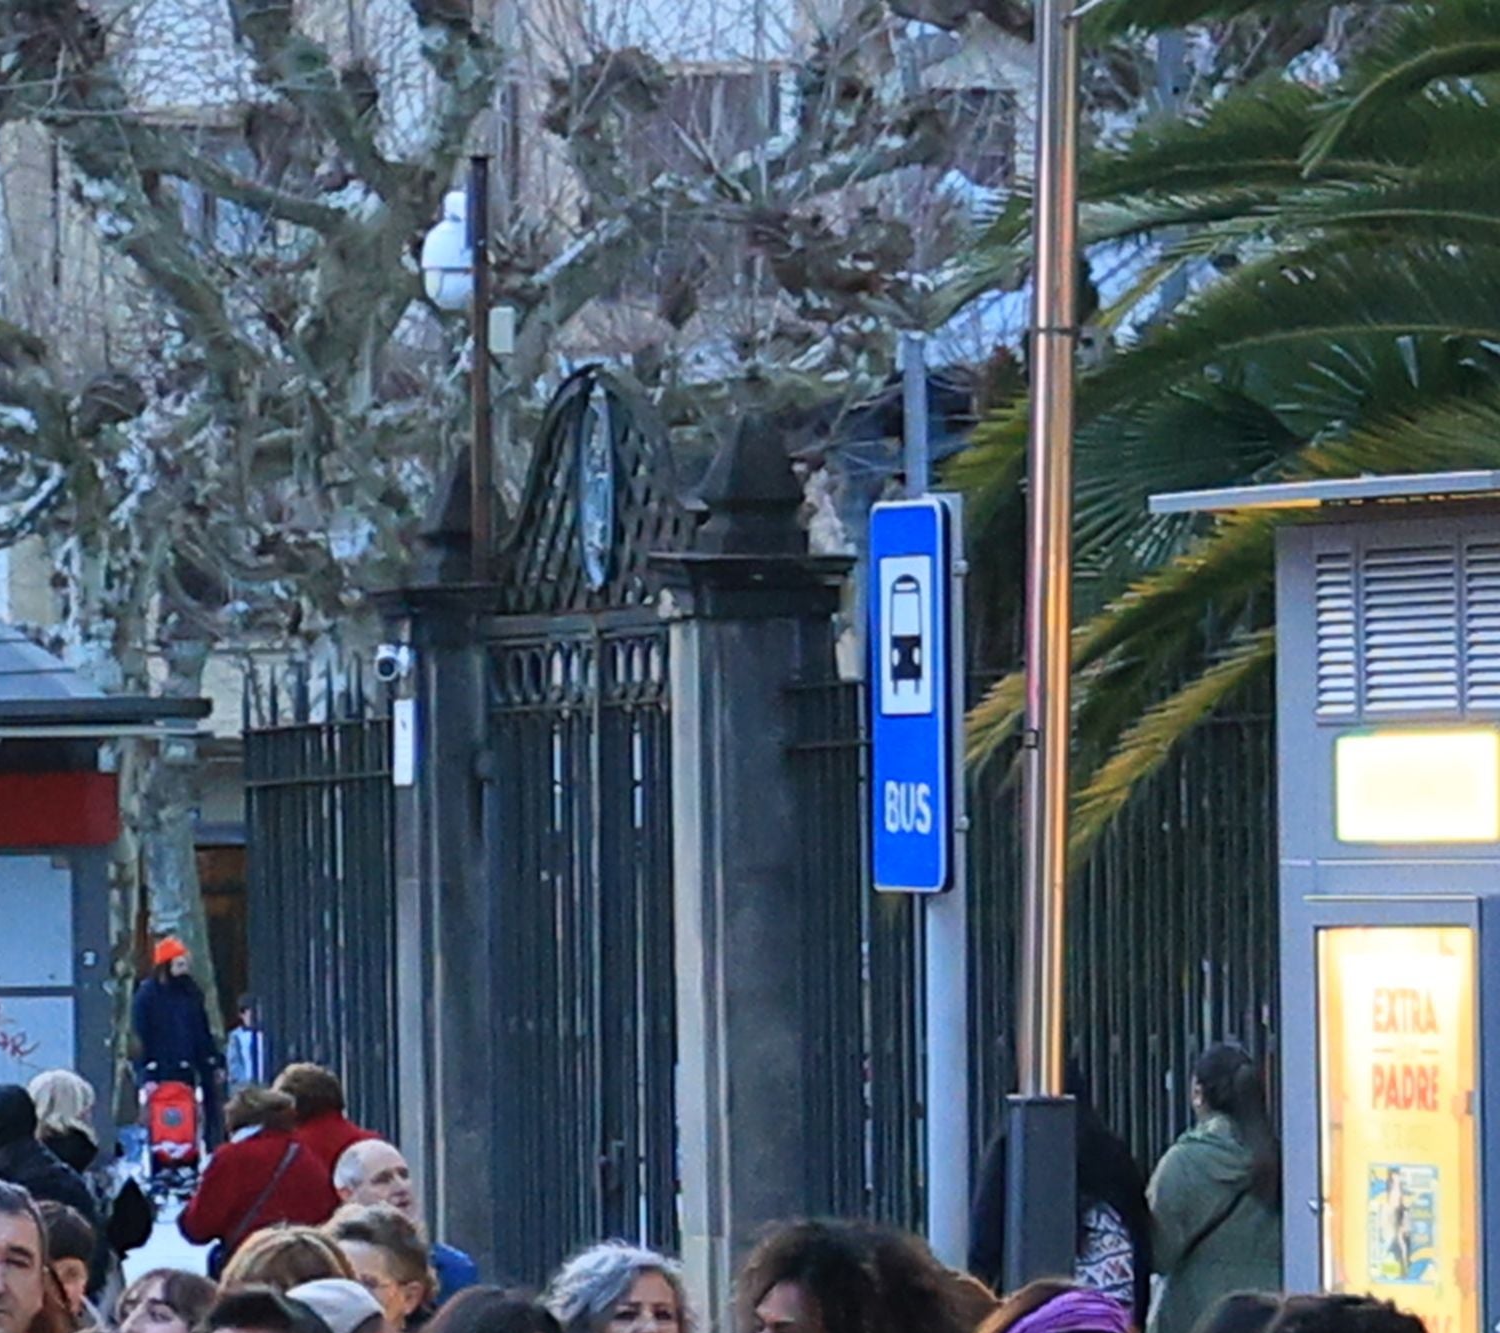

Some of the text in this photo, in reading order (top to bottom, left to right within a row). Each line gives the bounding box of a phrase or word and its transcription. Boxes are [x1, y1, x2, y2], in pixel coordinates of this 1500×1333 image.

[884, 779, 932, 835] BUS
[1372, 988, 1438, 1034] EXTRA
[1371, 1063, 1439, 1113] PADRE
